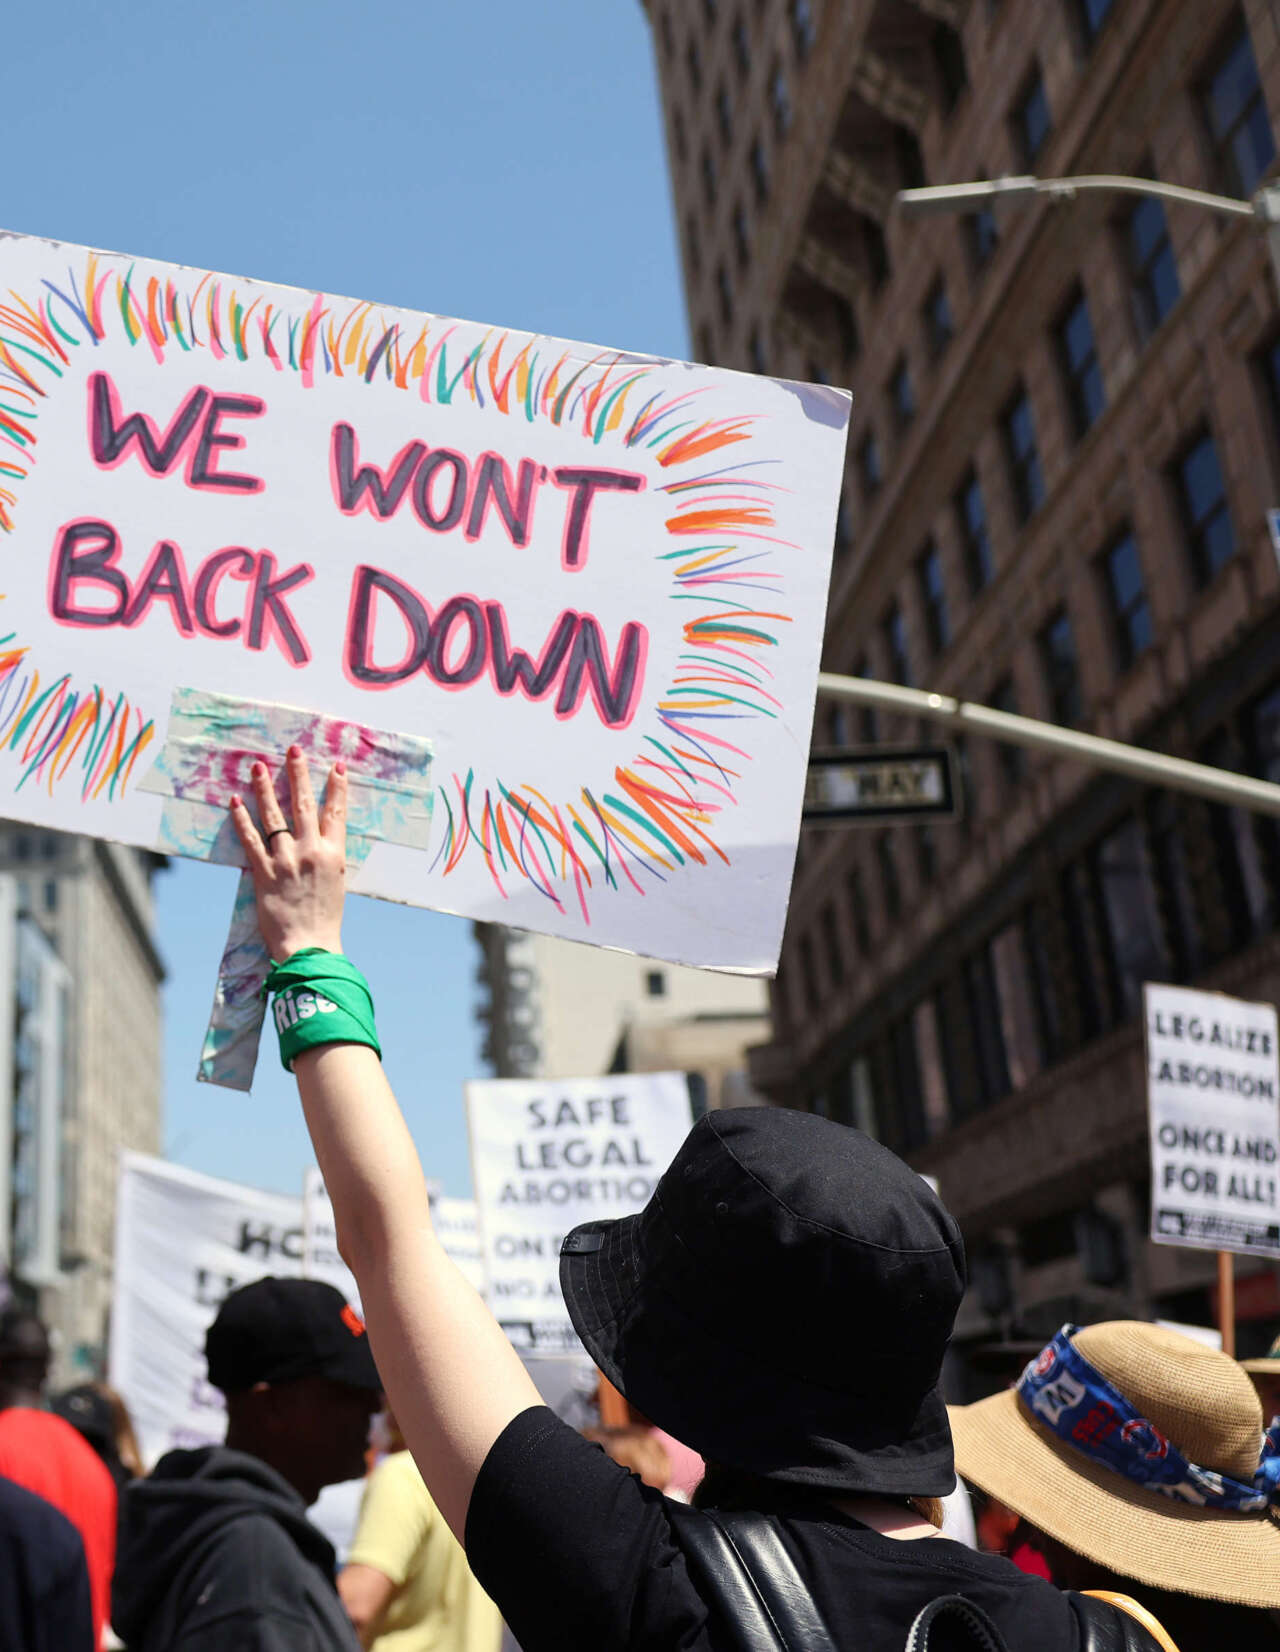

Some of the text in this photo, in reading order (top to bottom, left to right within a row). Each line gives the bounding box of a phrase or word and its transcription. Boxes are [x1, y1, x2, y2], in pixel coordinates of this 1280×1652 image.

[88, 371, 647, 572] WE WON'T
[47, 517, 649, 729] BACK DOWN
[1154, 1013, 1273, 1055] LEGALIZE
[526, 1095, 631, 1130] SAFE
[516, 1138, 652, 1171] LEGAL
[1158, 1124, 1278, 1164] ONCE AND
[500, 1175, 657, 1205] ABORTIO
[1162, 1165, 1277, 1206] FOR ALL!
[495, 1235, 543, 1258] ON
